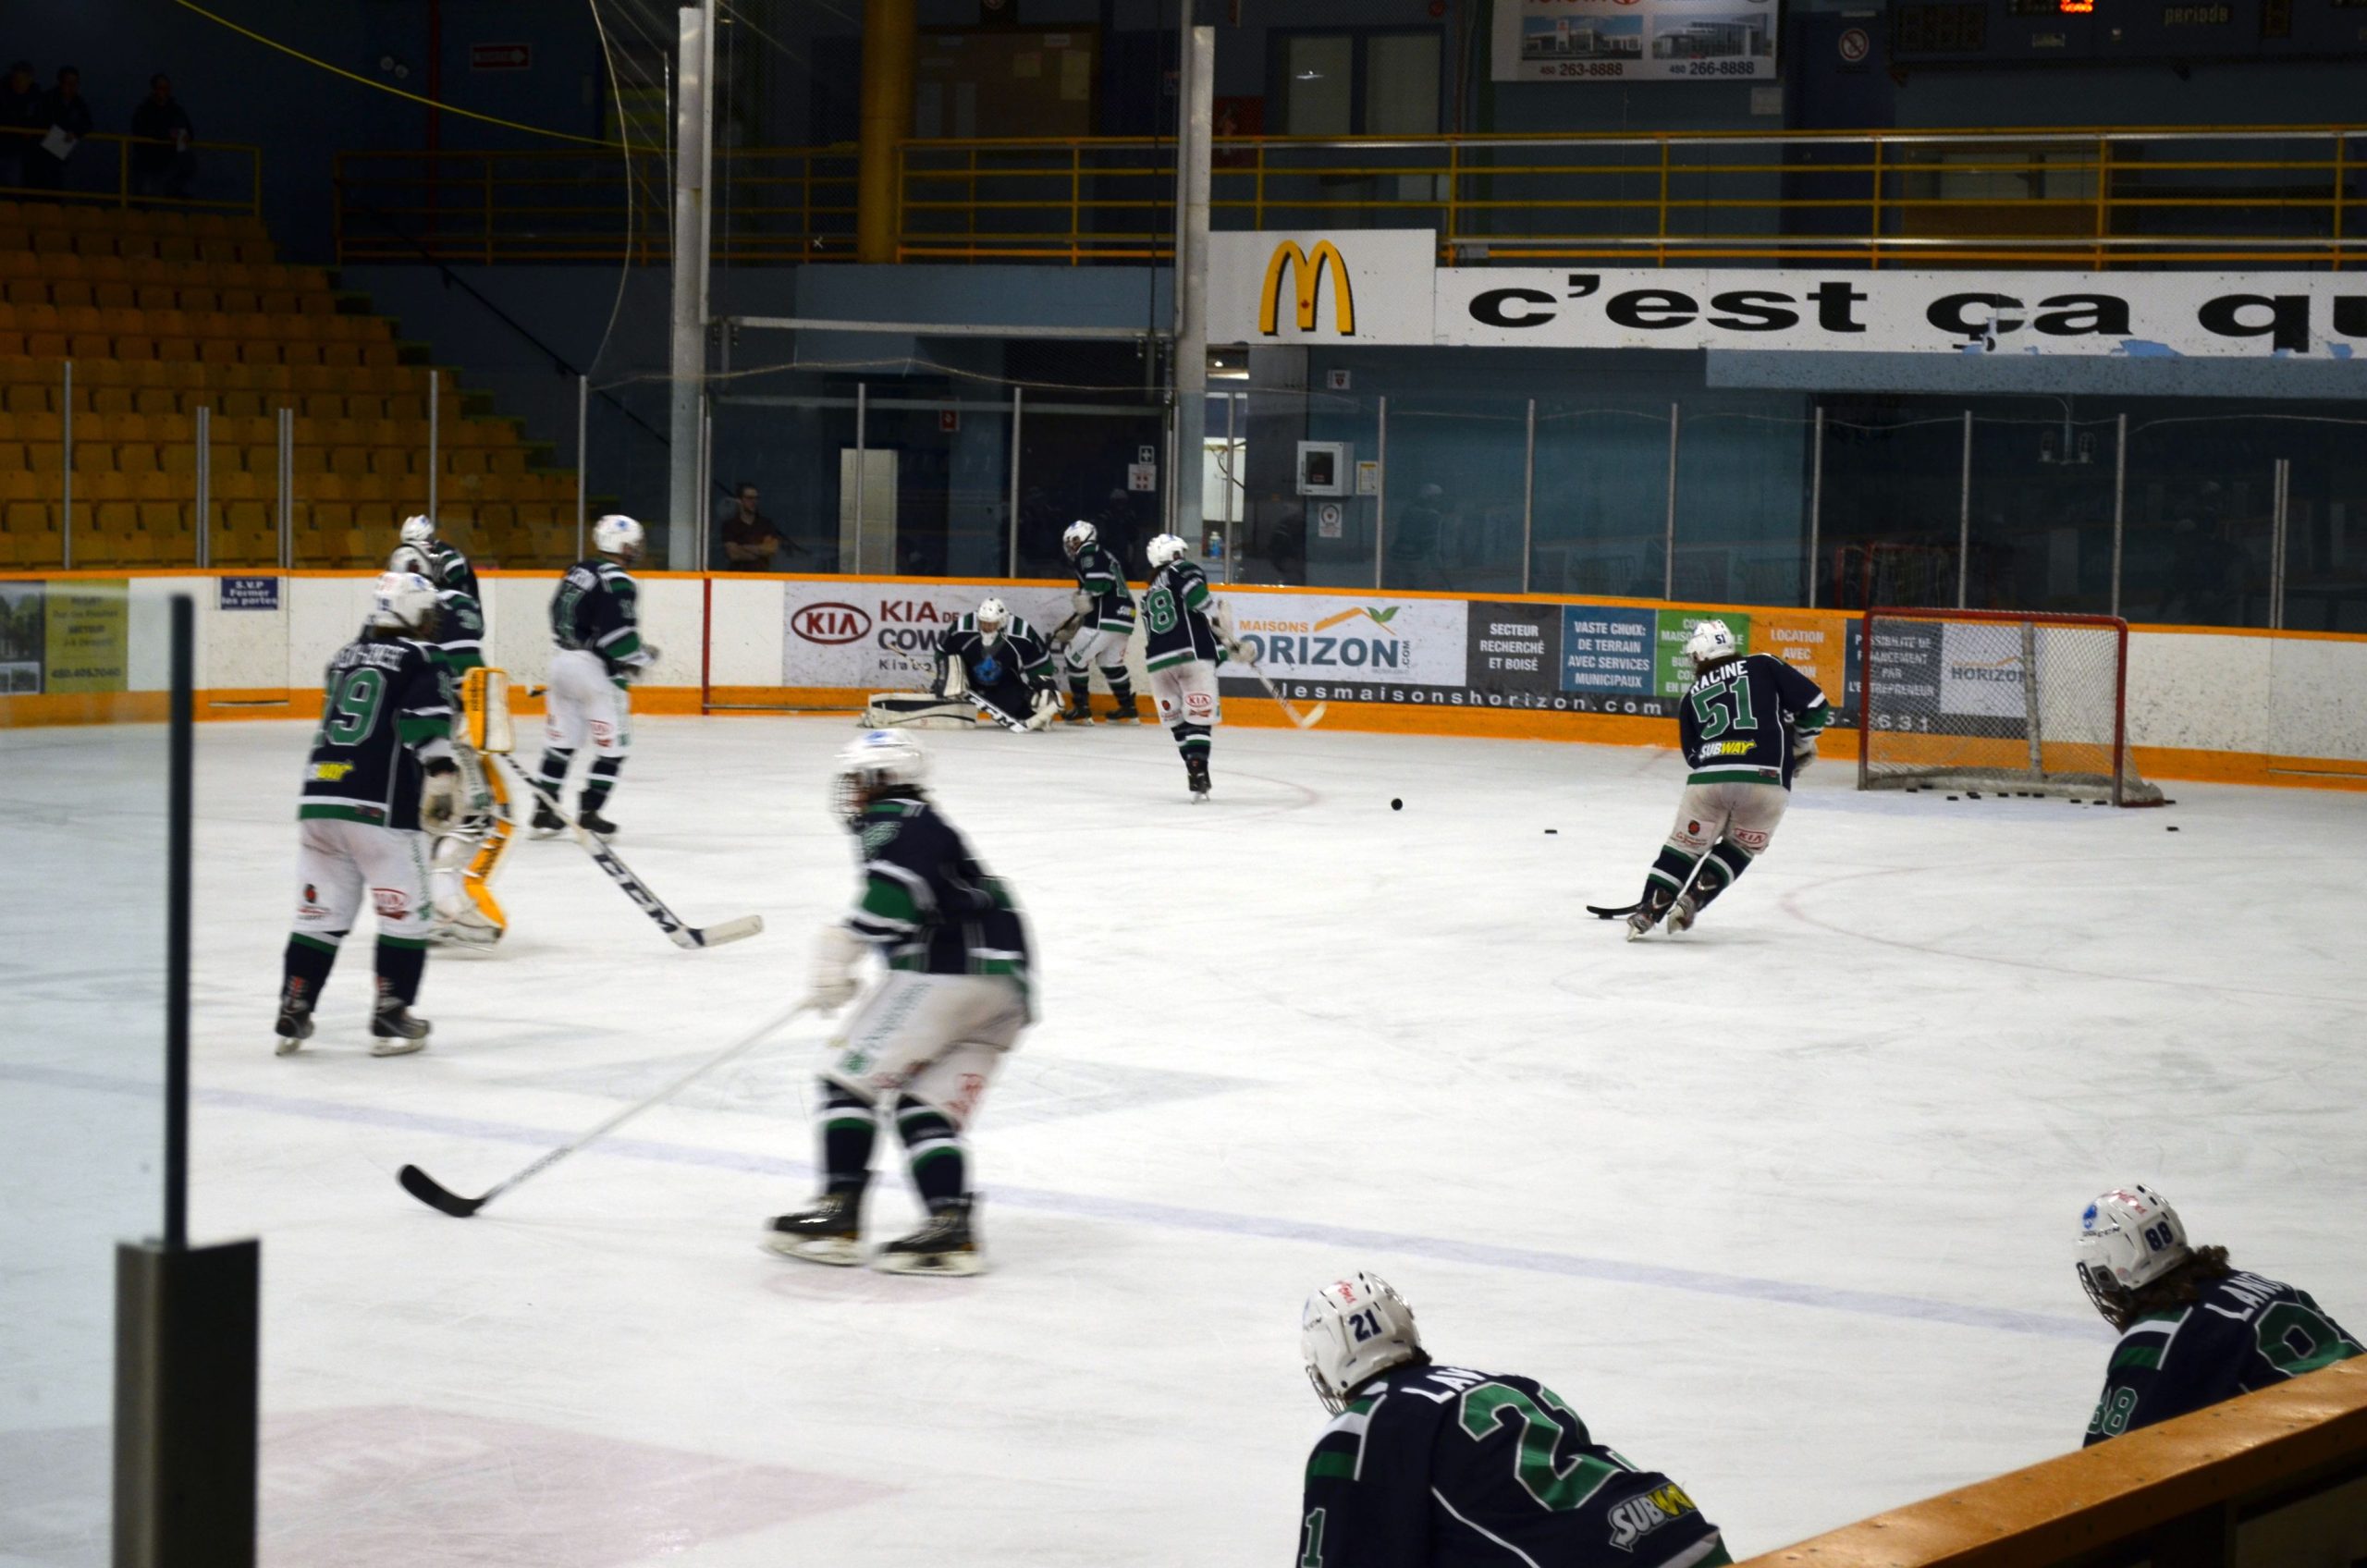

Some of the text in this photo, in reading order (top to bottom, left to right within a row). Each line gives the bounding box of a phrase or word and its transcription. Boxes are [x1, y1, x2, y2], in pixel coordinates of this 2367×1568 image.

[1560, 63, 1624, 77] 263-8888
[1690, 61, 1755, 76] 266-8888
[1468, 275, 1868, 333] c'est
[1926, 292, 2133, 352] ça
[880, 600, 938, 624] KIA
[805, 612, 861, 636] KIA
[1239, 620, 1309, 633] MAISONS
[1490, 623, 1539, 637] SECTEUR
[1574, 621, 1608, 634] VASTE
[1715, 633, 1727, 645] 51
[1771, 629, 1825, 643] LOCATION
[1239, 633, 1399, 668] ORIZON
[1479, 640, 1545, 655] RECHERCHÉ
[1577, 638, 1641, 654] DE TERRAIN
[1782, 647, 1811, 660] AVEC
[1489, 656, 1539, 671] ET BOISÉ
[1567, 655, 1650, 671] AVEC SERVICES
[1575, 672, 1643, 689] MUNICIPAUX
[1690, 676, 1757, 740] 51
[1699, 740, 1757, 761] SUBWAY
[1738, 831, 1767, 845] KIA
[2144, 1220, 2174, 1252] 88
[1348, 1308, 1383, 1342] 21
